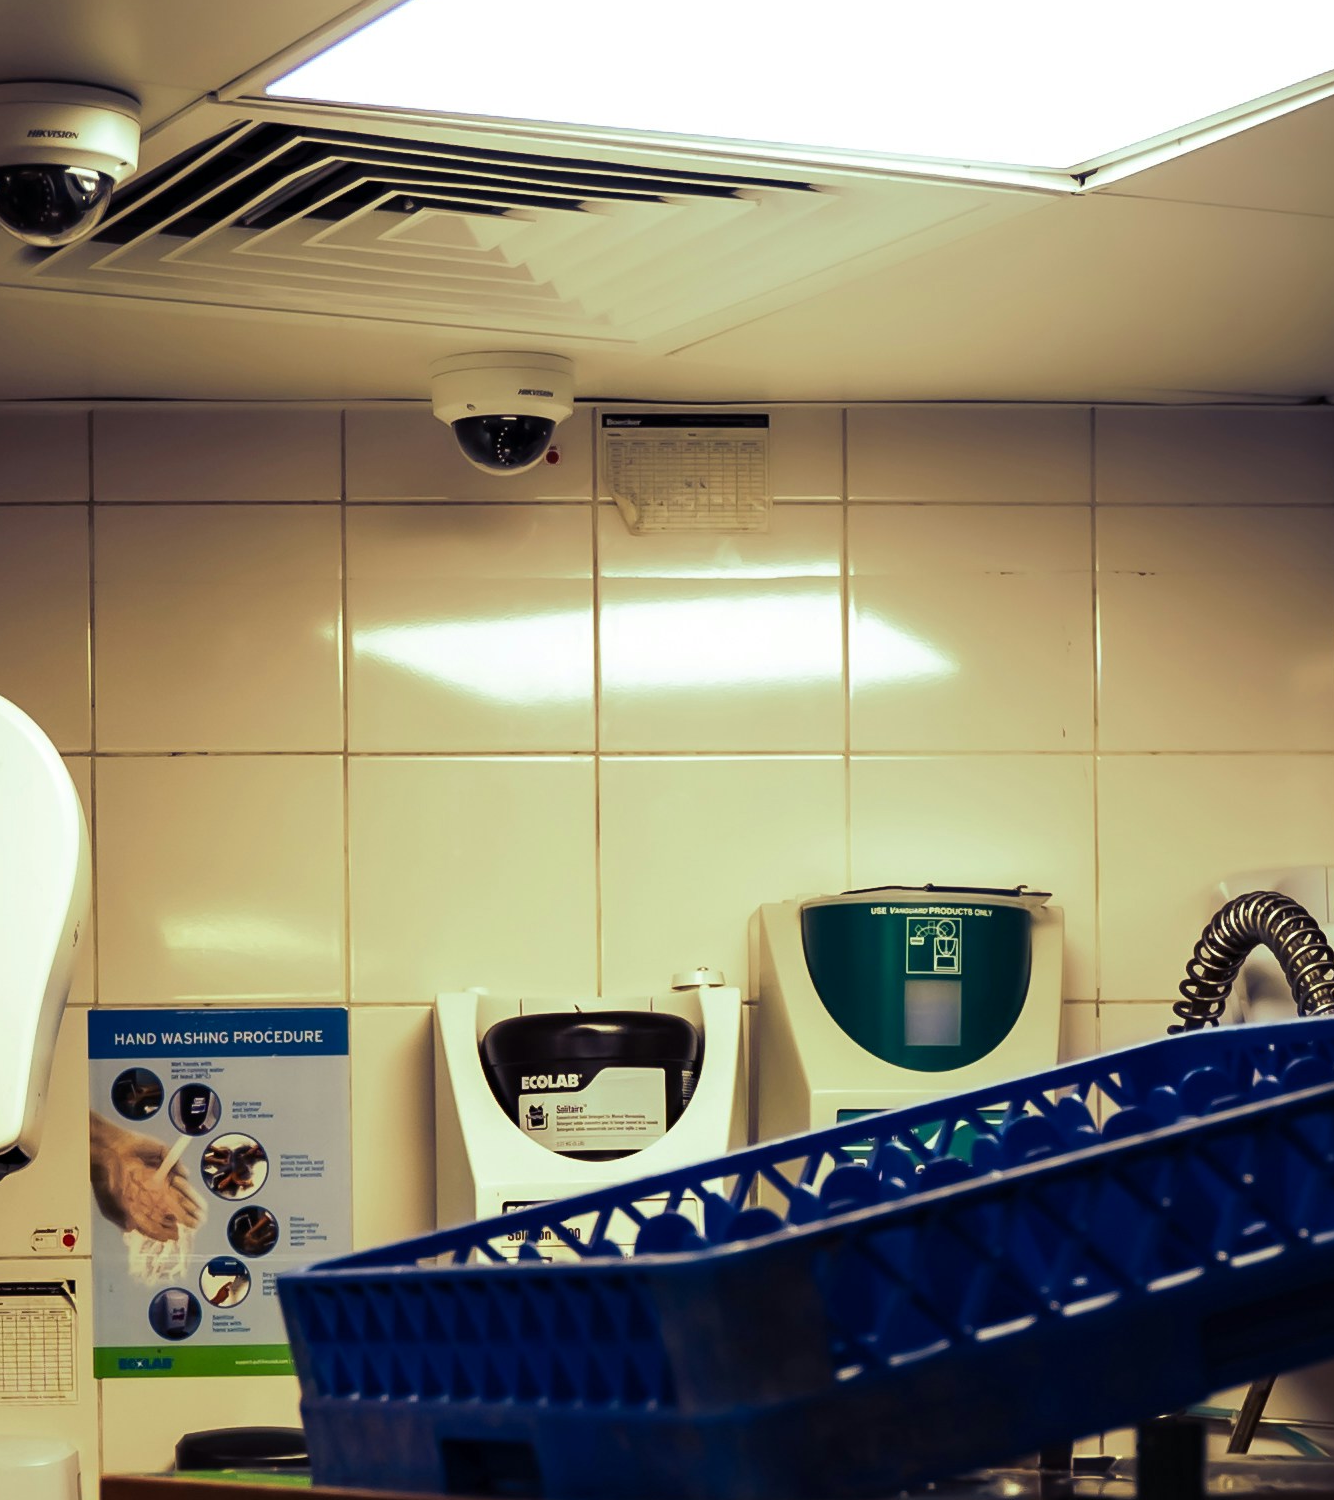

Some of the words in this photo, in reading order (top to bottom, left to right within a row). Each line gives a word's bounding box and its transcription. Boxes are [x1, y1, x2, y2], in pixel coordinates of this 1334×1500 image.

[27, 129, 79, 139] HIKVISION
[870, 907, 887, 915] USE
[928, 906, 974, 916] PRODUCTS
[974, 908, 993, 917] ONLY
[114, 1032, 158, 1046] HAND
[160, 1031, 229, 1045] WASHING
[233, 1030, 324, 1044] PROCEDURE
[521, 1074, 580, 1090] ECOLAB
[556, 1104, 584, 1114] Solitaire
[119, 1357, 173, 1370] ECOLAB
